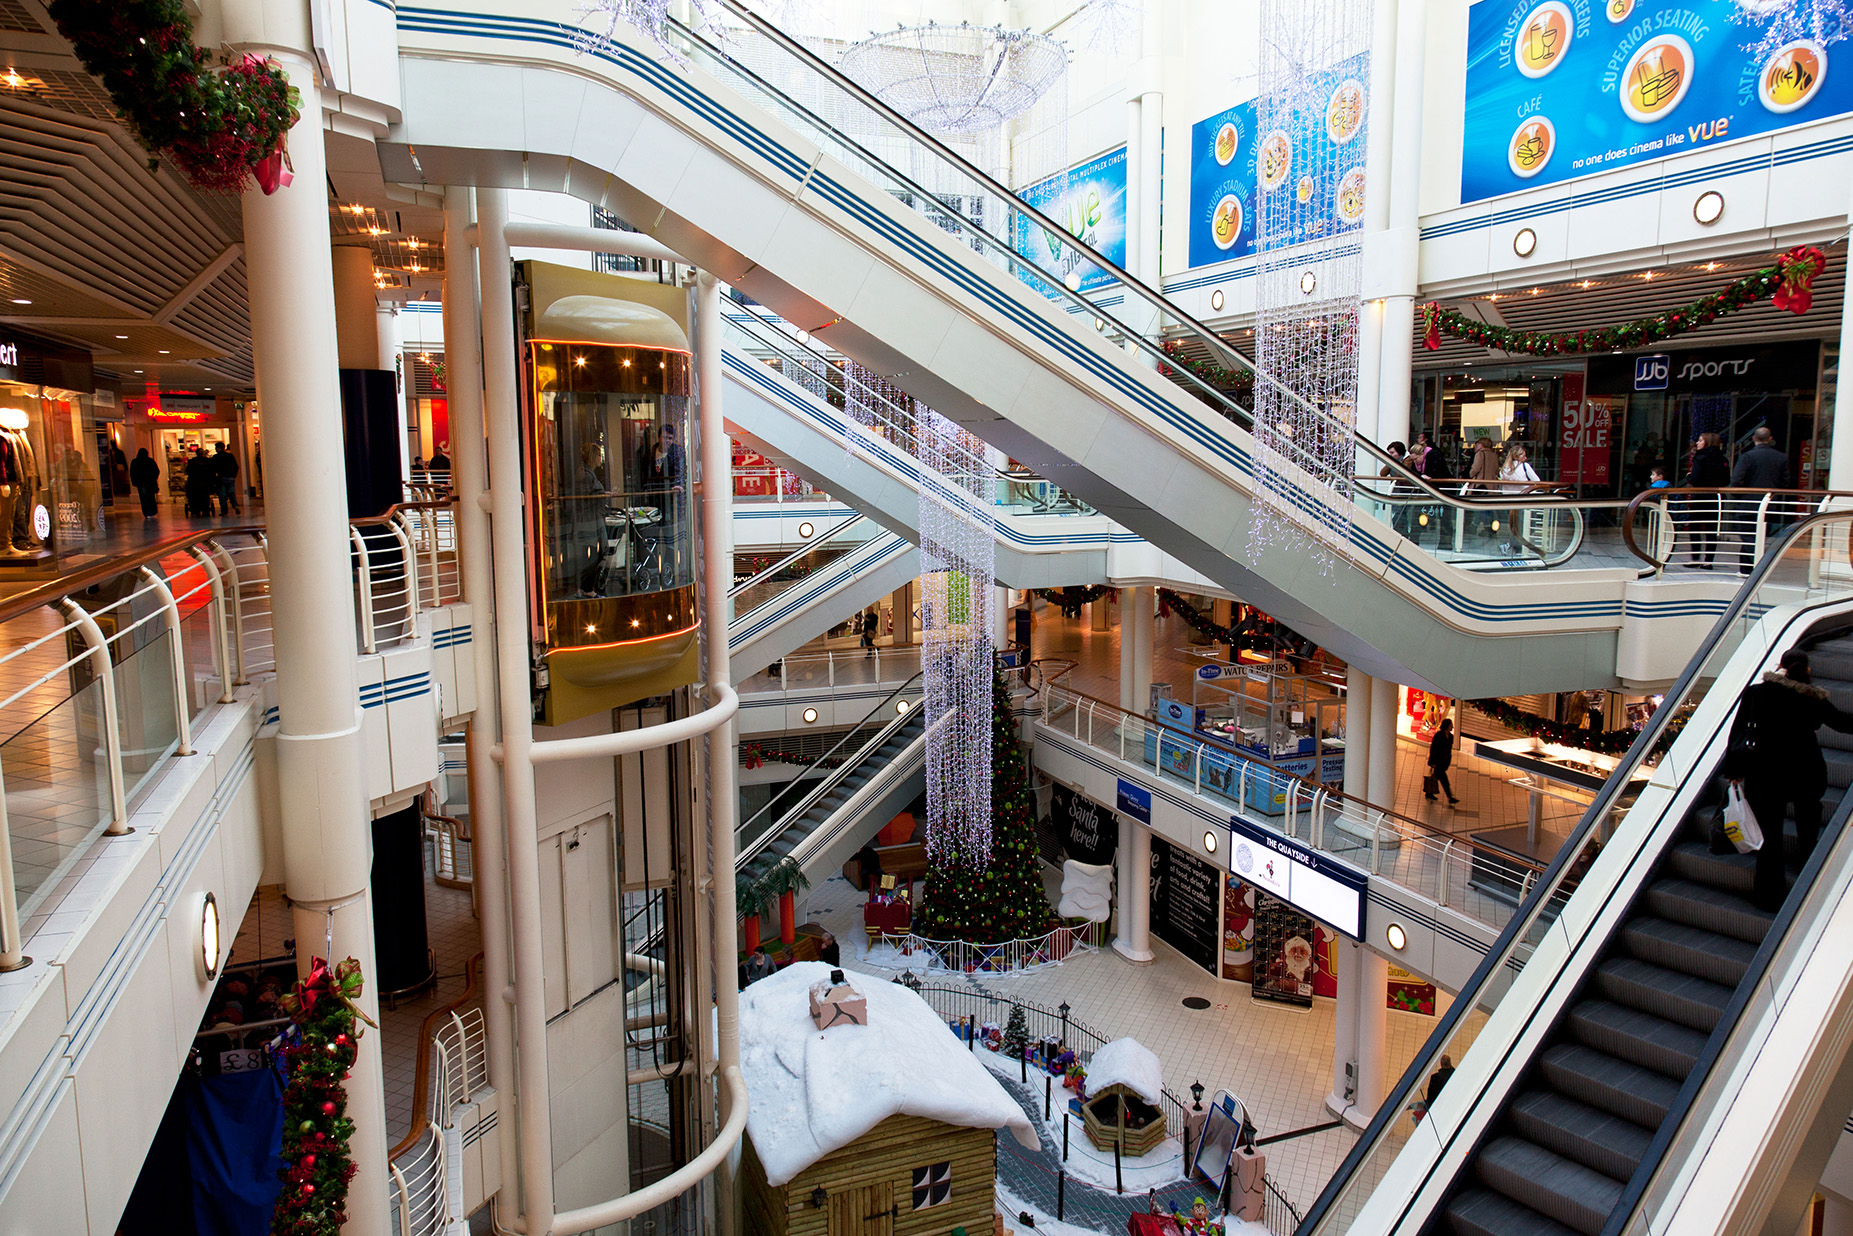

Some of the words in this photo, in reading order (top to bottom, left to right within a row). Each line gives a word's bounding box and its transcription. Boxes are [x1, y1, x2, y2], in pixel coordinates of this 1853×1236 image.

[1498, 1, 1529, 69] LICENSED
[1602, 17, 1654, 93] SUPERIOR
[1654, 8, 1710, 43] SEATING
[1517, 93, 1543, 118] CAFÉ
[1572, 158, 1584, 169] no
[1585, 153, 1603, 167] one
[1604, 147, 1628, 162] does
[1629, 138, 1664, 155] cinema
[1665, 132, 1685, 147] like
[1205, 184, 1223, 223] LUXURY
[1223, 179, 1249, 203] STADIUM
[1243, 200, 1252, 232] SEATS
[0, 342, 18, 367] ert
[1677, 358, 1756, 382] sports
[1473, 428, 1490, 436] NEW
[1595, 418, 1609, 428] OFF
[1562, 429, 1608, 449] SALE
[1256, 663, 1289, 674] REPAIRS
[1069, 796, 1099, 834] Santa
[1070, 823, 1099, 851] here!!
[1185, 853, 1197, 866] with
[1266, 836, 1277, 849] THE
[1277, 841, 1309, 865] QUAYSIDE
[1169, 854, 1192, 873] fantastic
[1192, 867, 1211, 885] variety
[1169, 865, 1175, 873] of
[1175, 868, 1189, 882] food,
[1190, 877, 1206, 893] drink,
[1169, 876, 1180, 886] arts
[1180, 882, 1191, 893] and
[224, 1052, 259, 1071] £8
